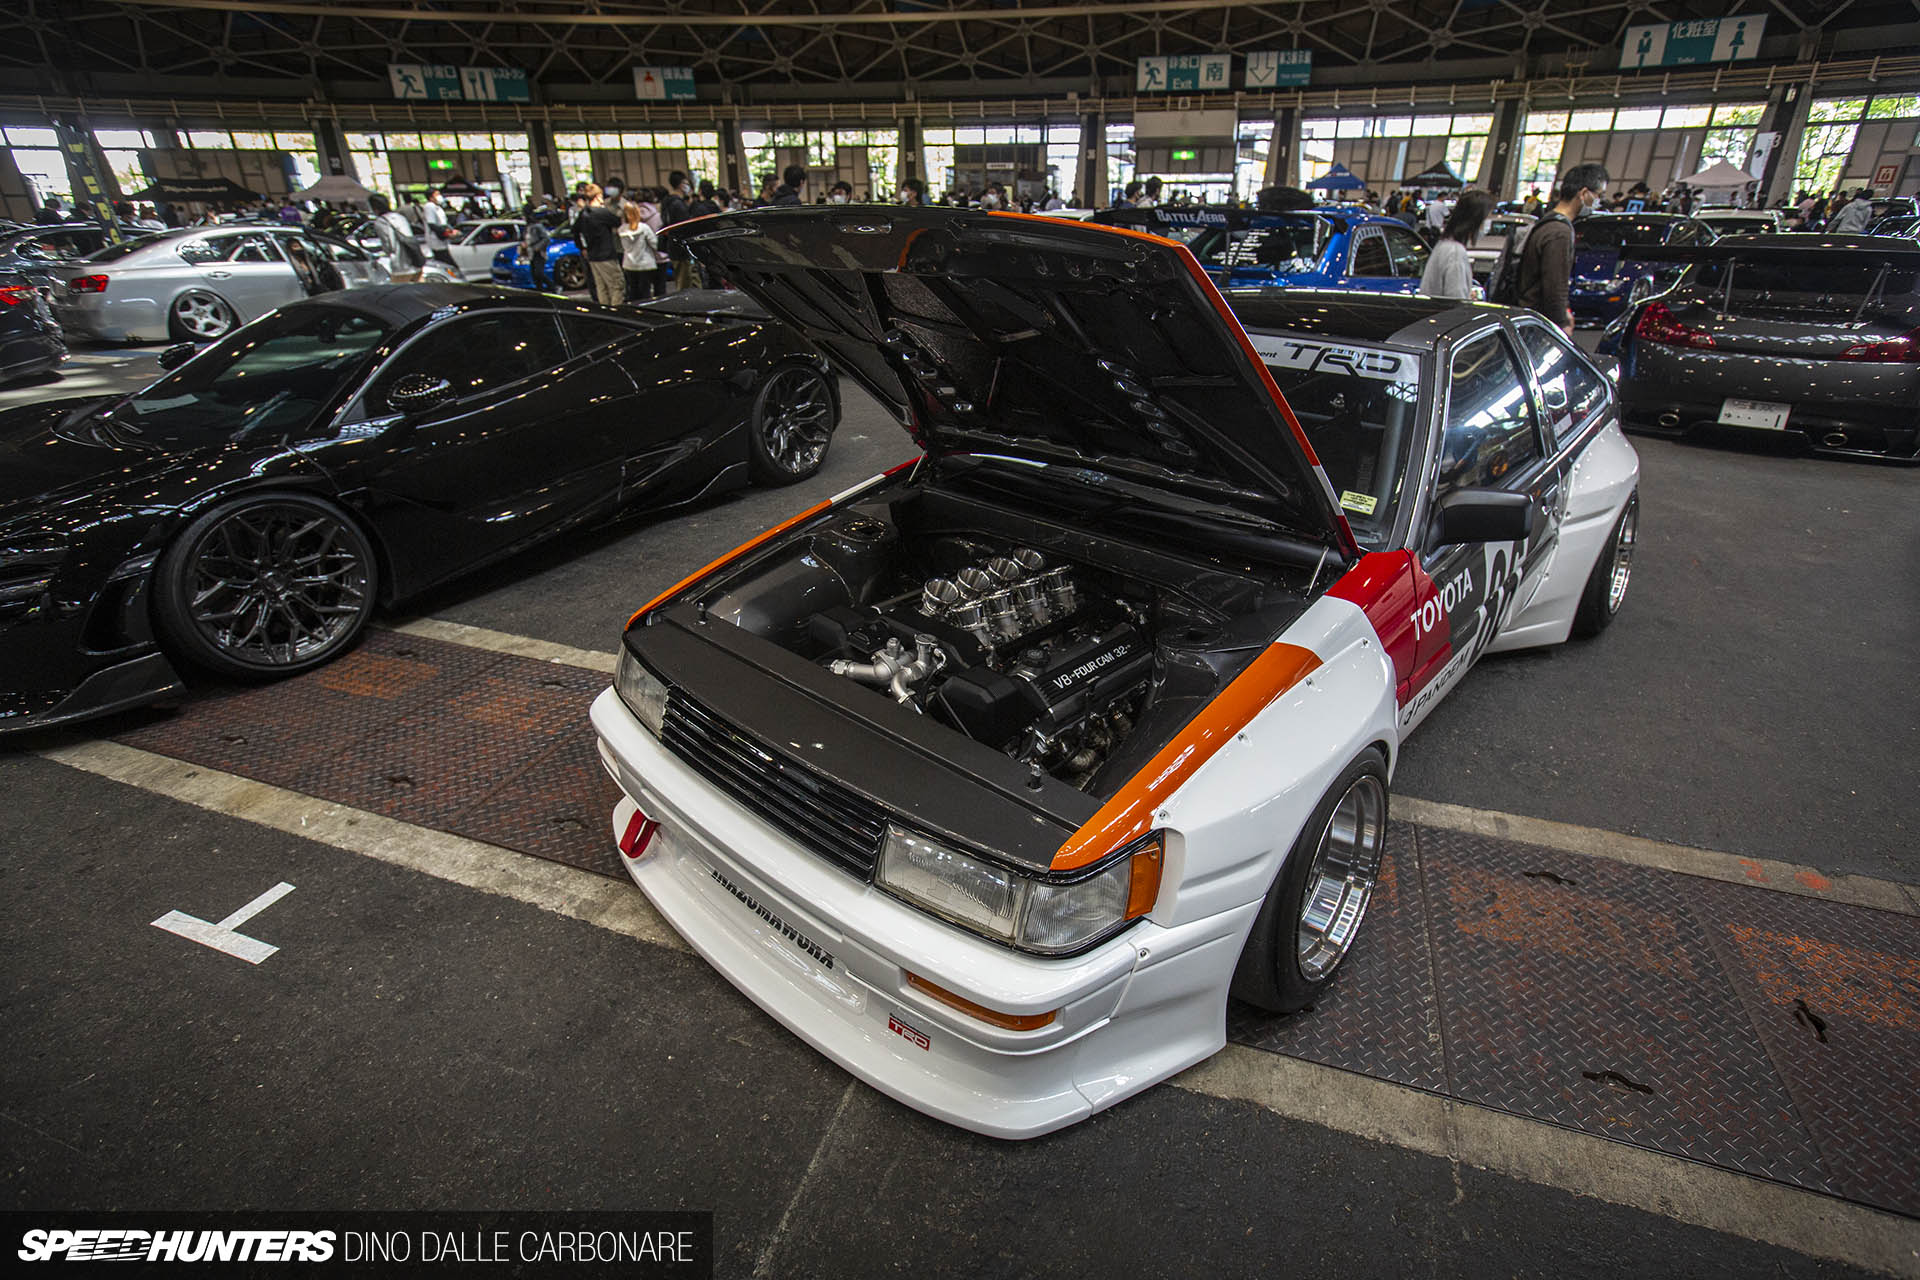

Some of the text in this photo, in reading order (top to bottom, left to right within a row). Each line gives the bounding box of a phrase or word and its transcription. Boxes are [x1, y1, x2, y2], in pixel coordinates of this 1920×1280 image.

[1672, 20, 1718, 39] 化粧室
[1172, 78, 1192, 90] Exit
[1206, 62, 1225, 81] 南
[1284, 342, 1401, 377] TRD
[1410, 567, 1473, 641] TOYOTA
[1053, 645, 1128, 689] V8 FOUR CAM 32
[889, 1018, 929, 1049] TRD
